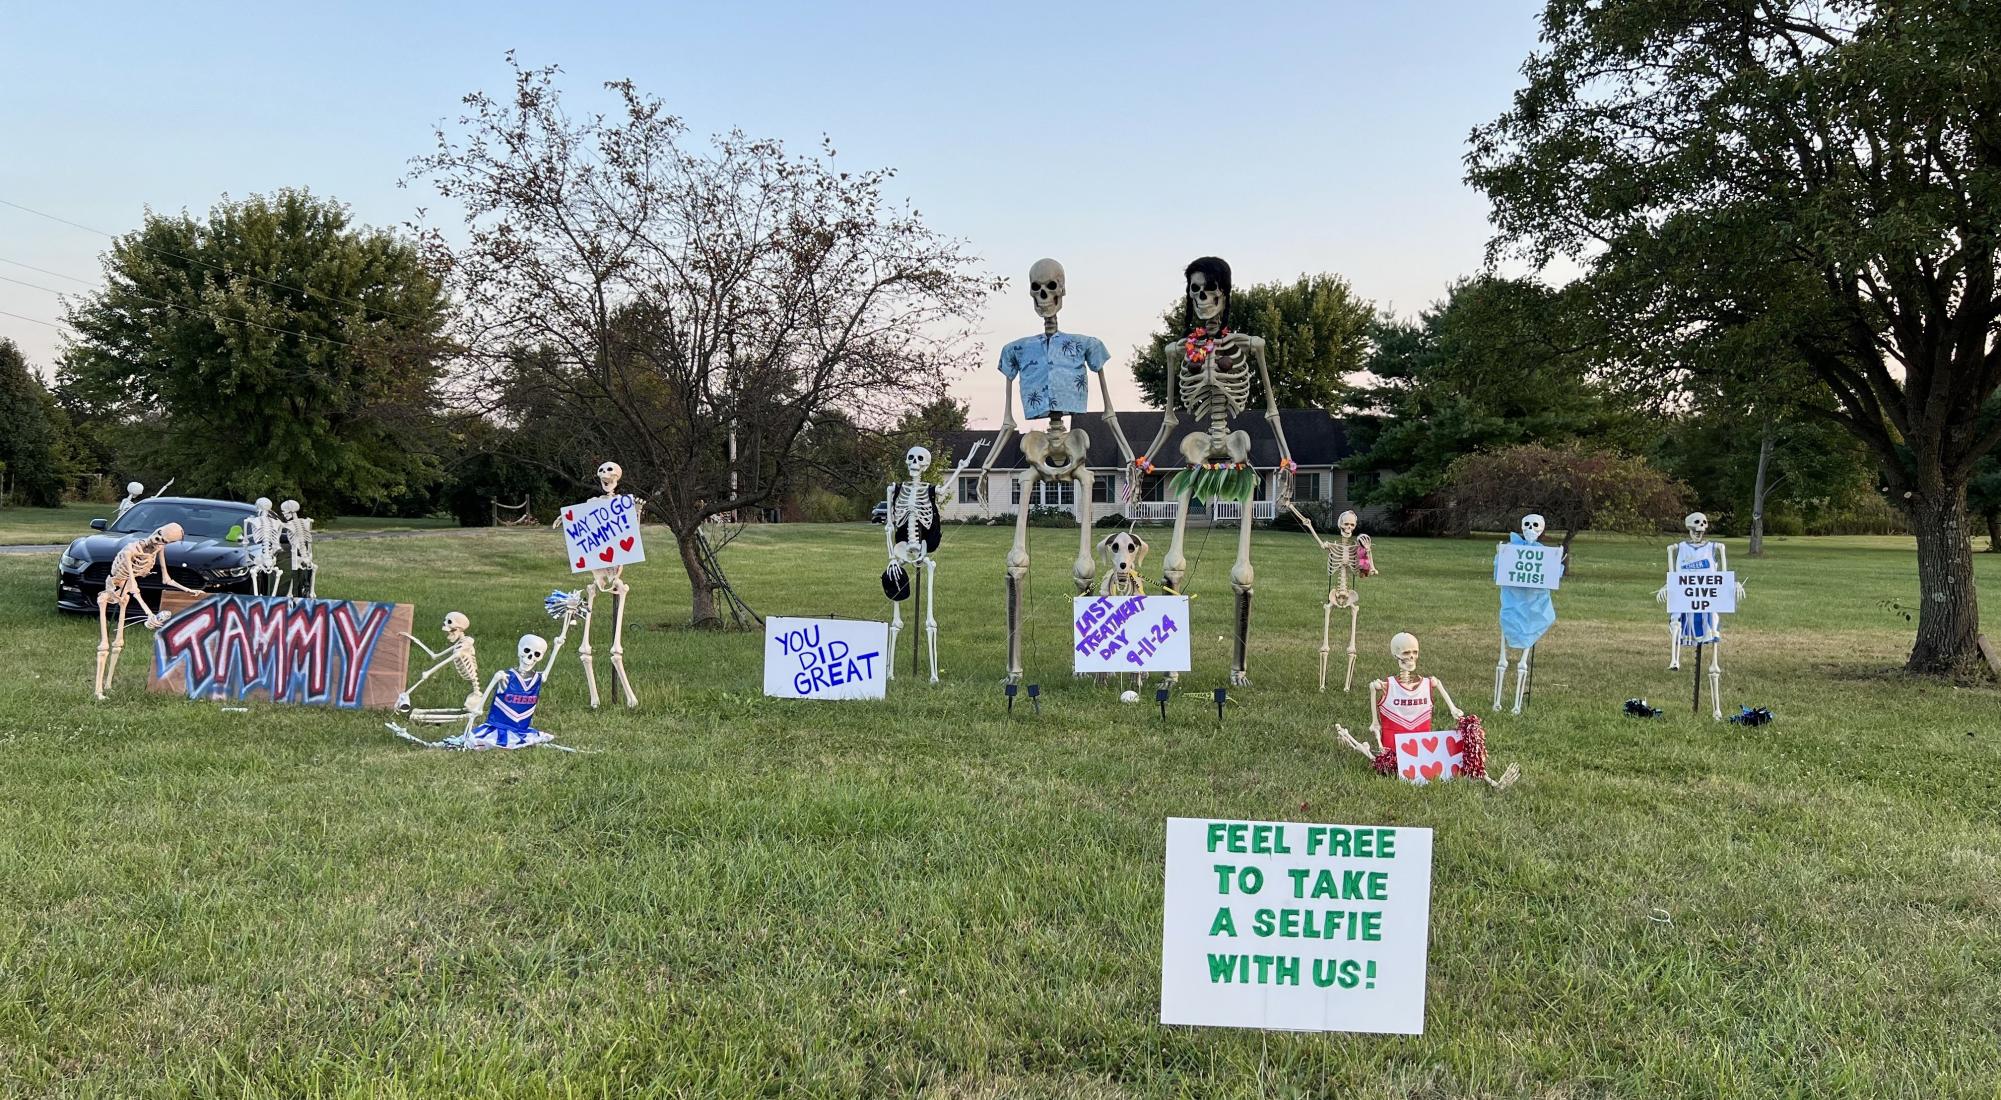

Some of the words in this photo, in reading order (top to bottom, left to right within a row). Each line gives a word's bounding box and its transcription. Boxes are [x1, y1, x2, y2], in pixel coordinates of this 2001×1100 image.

[566, 516, 590, 540] WAY
[589, 507, 609, 525] TO
[576, 514, 630, 553] TAMMY!
[1515, 561, 1542, 572] GOT
[1516, 549, 1543, 560] YOU
[1508, 572, 1544, 584] THIS!
[1679, 575, 1723, 585] NEVER
[1684, 587, 1717, 597] GIVE
[1075, 595, 1114, 637] LAST
[1691, 600, 1710, 610] UP
[774, 624, 820, 656] YOU
[1075, 595, 1148, 657] TREATMENT
[1126, 614, 1178, 667] 9-11-24
[158, 597, 393, 706] TAMMY
[798, 640, 849, 671] DID
[1099, 628, 1129, 661] DAY
[794, 651, 879, 695] GREAT
[1393, 697, 1428, 706] CHEERS
[1206, 823, 1291, 854] FEEL
[1306, 827, 1396, 858] FREE
[1213, 865, 1264, 895] TO
[1287, 868, 1389, 900] TAKE
[1208, 907, 1238, 937] A
[1252, 908, 1382, 941] SELFIE
[1206, 953, 1300, 986] WITH
[1312, 958, 1377, 990] US!
